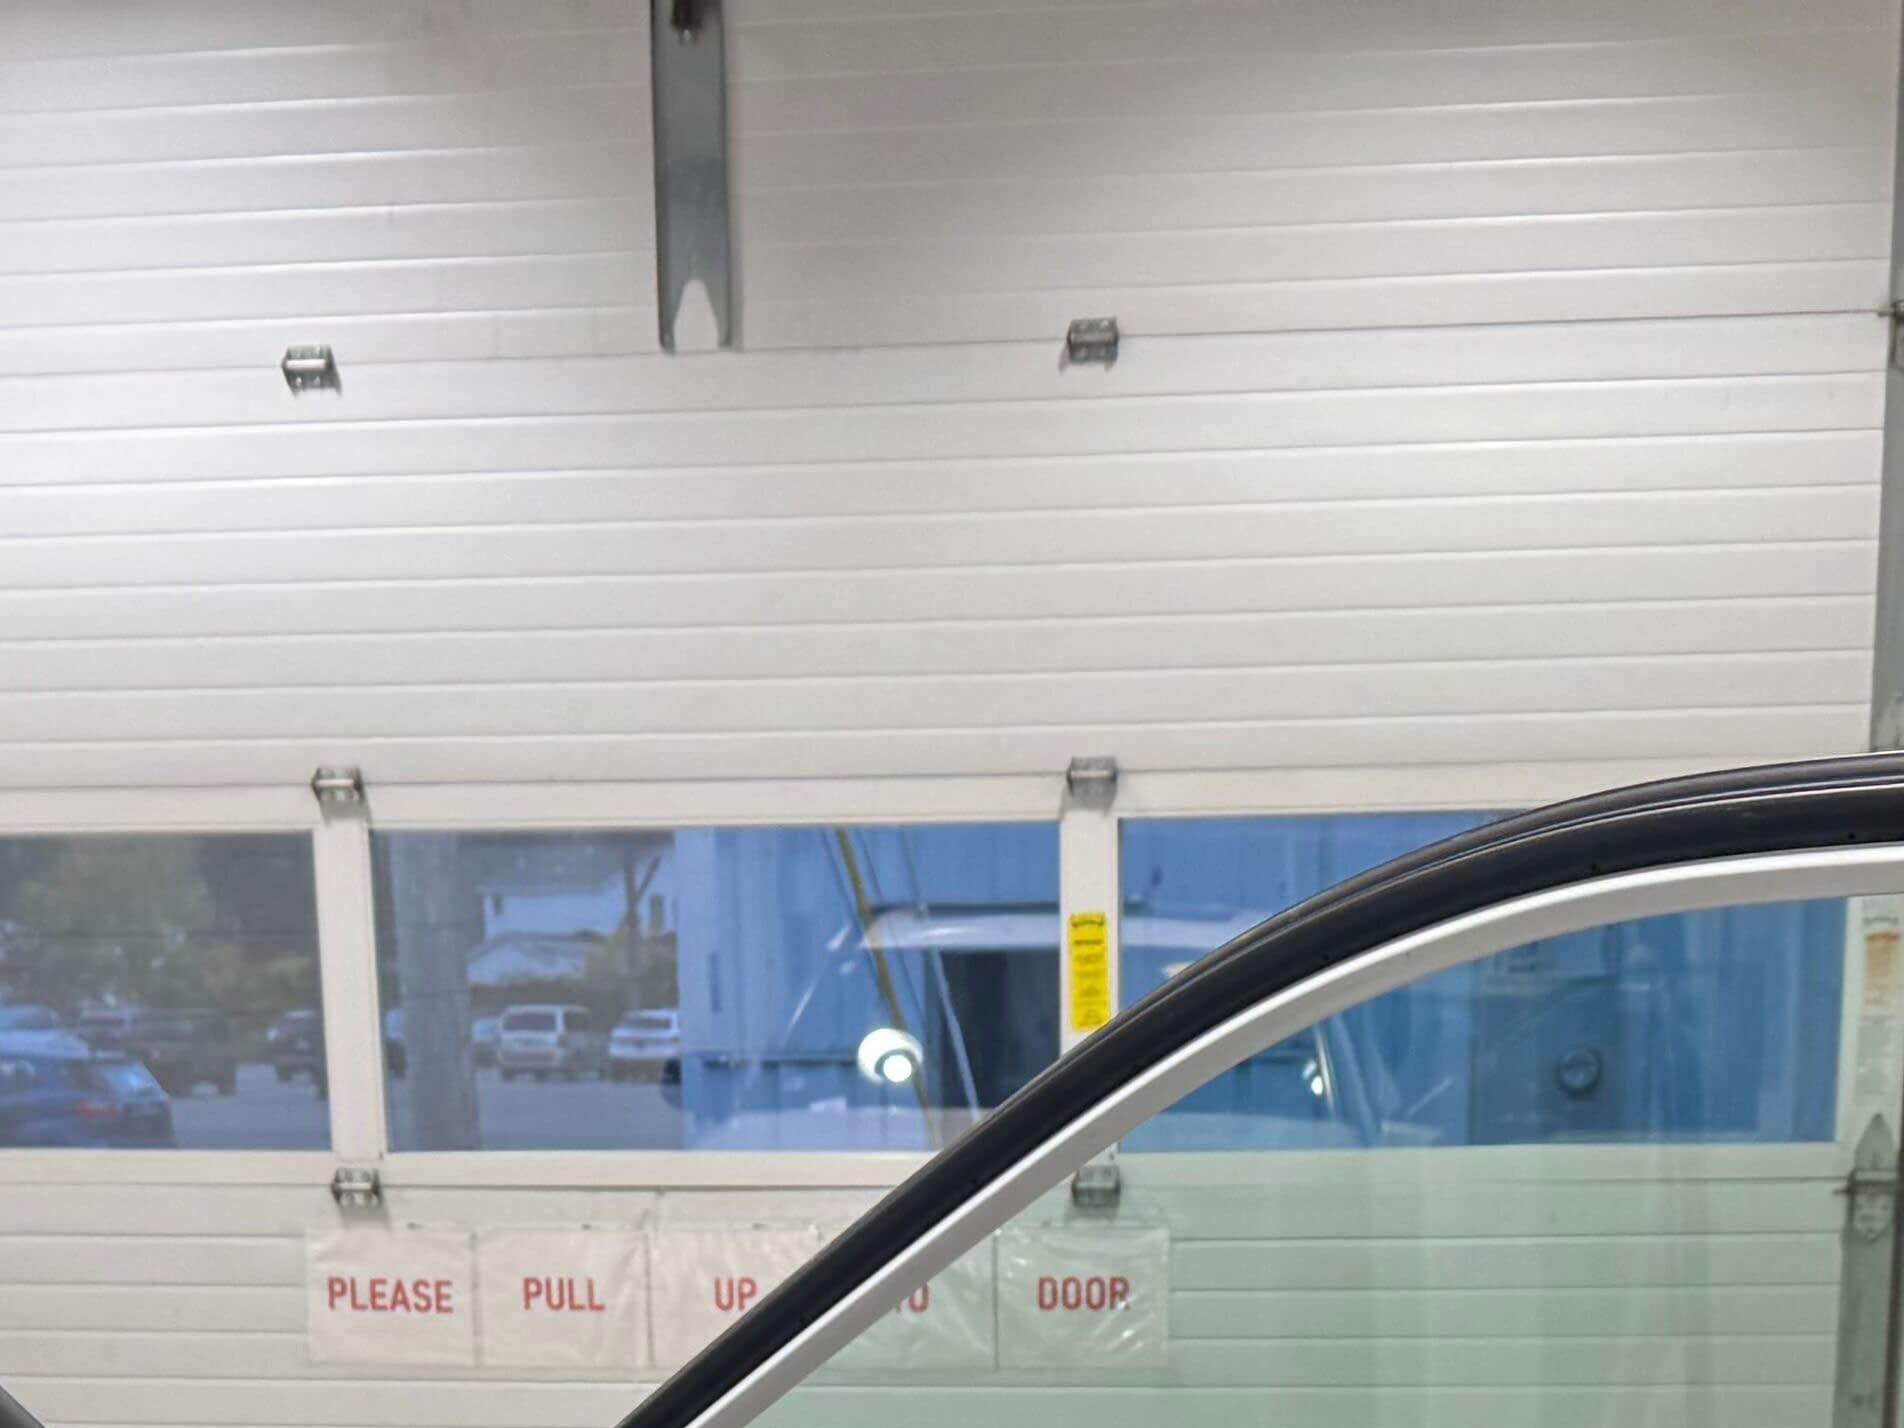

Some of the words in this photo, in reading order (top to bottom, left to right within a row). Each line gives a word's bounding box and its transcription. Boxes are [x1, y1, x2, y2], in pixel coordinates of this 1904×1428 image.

[327, 1275, 454, 1315] PLEASE
[522, 1275, 606, 1312] PULL
[713, 1275, 758, 1311] UP
[1036, 1275, 1130, 1312] DOOR
